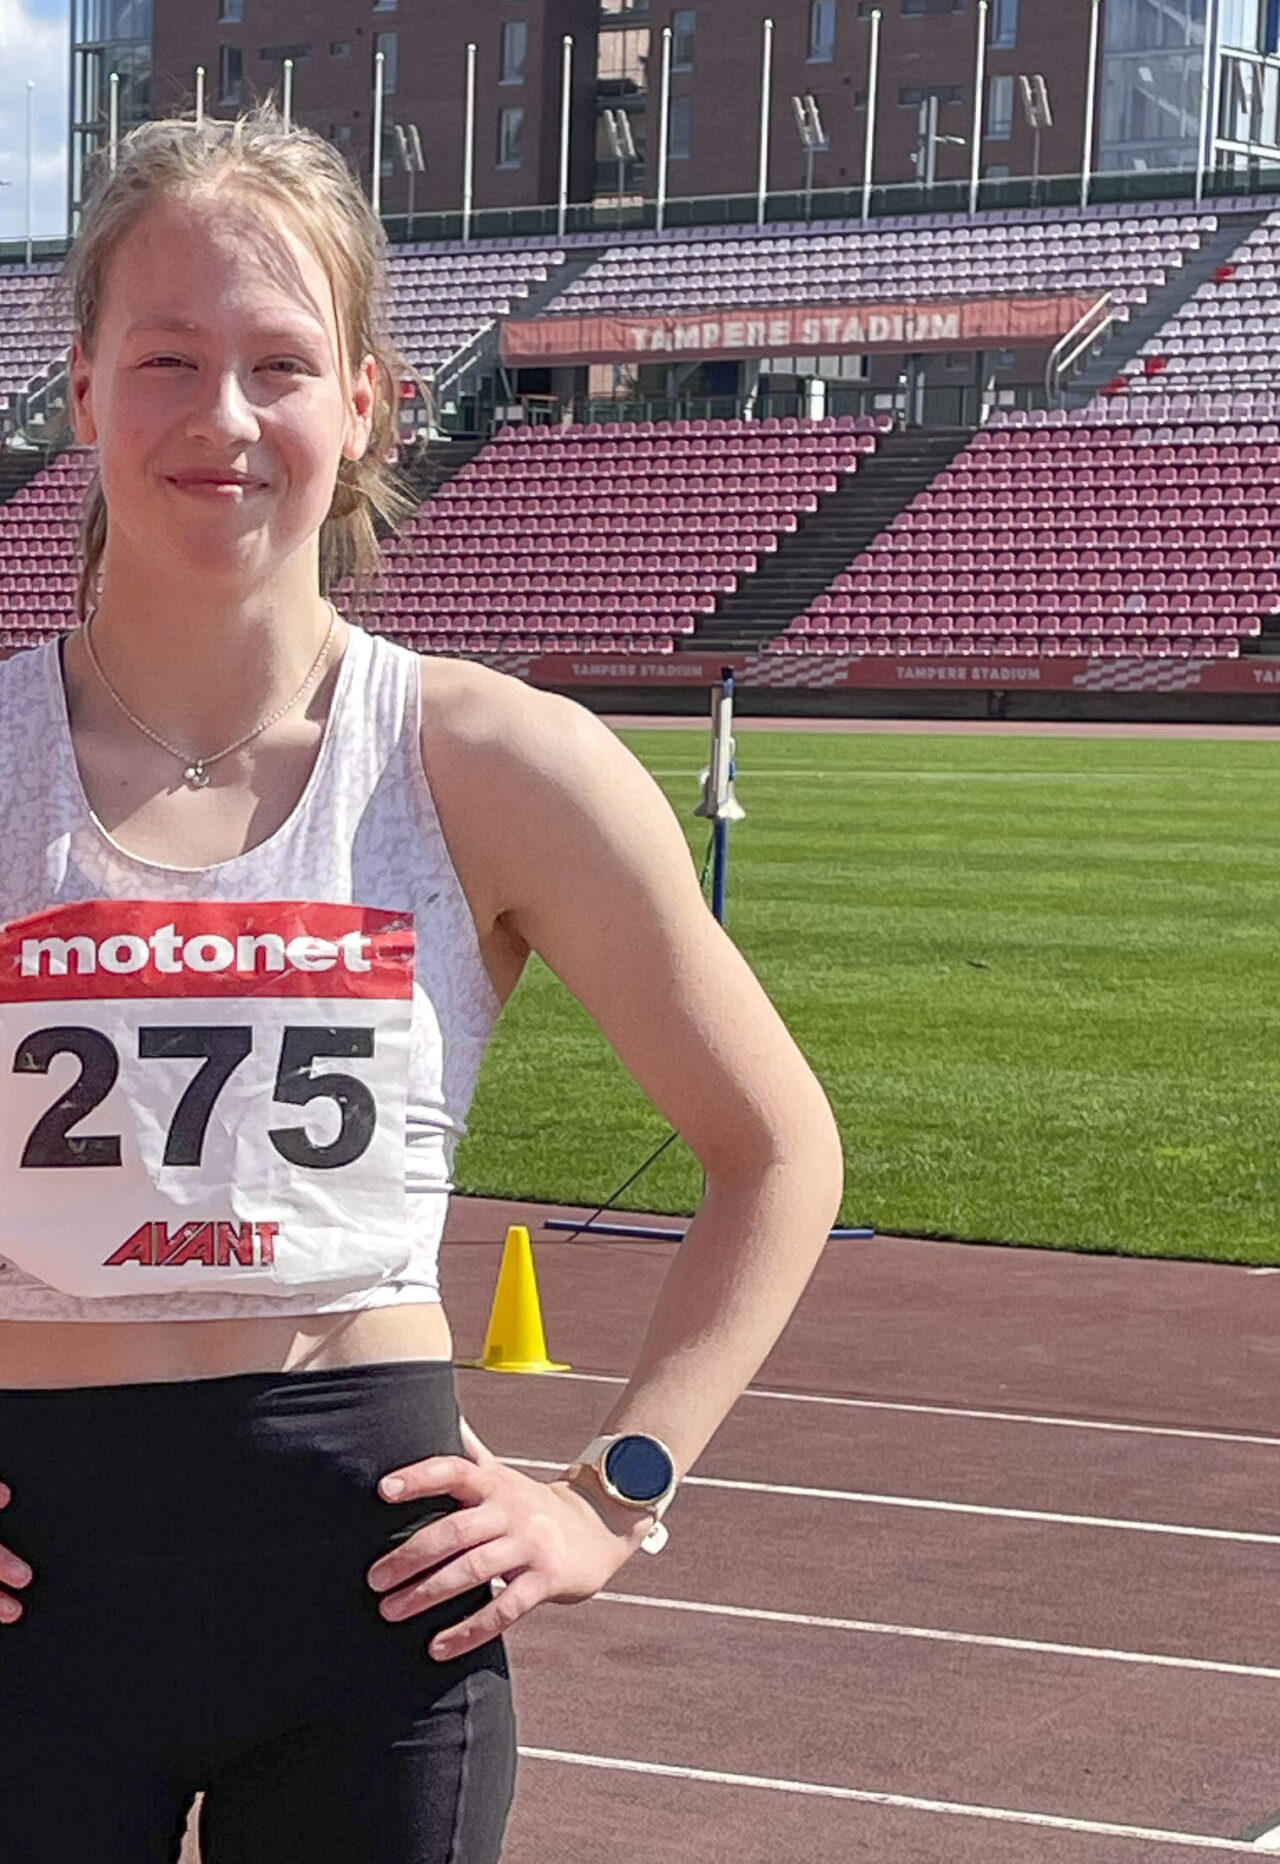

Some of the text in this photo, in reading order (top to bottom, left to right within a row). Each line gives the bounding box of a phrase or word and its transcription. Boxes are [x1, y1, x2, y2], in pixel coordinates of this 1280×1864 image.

[631, 314, 958, 351] TAMPERE STADIUM
[896, 666, 1040, 681] TAMPERE STADIUM
[21, 924, 371, 975] motonet
[12, 1025, 376, 1168] 275
[104, 1221, 278, 1266] AVANT
